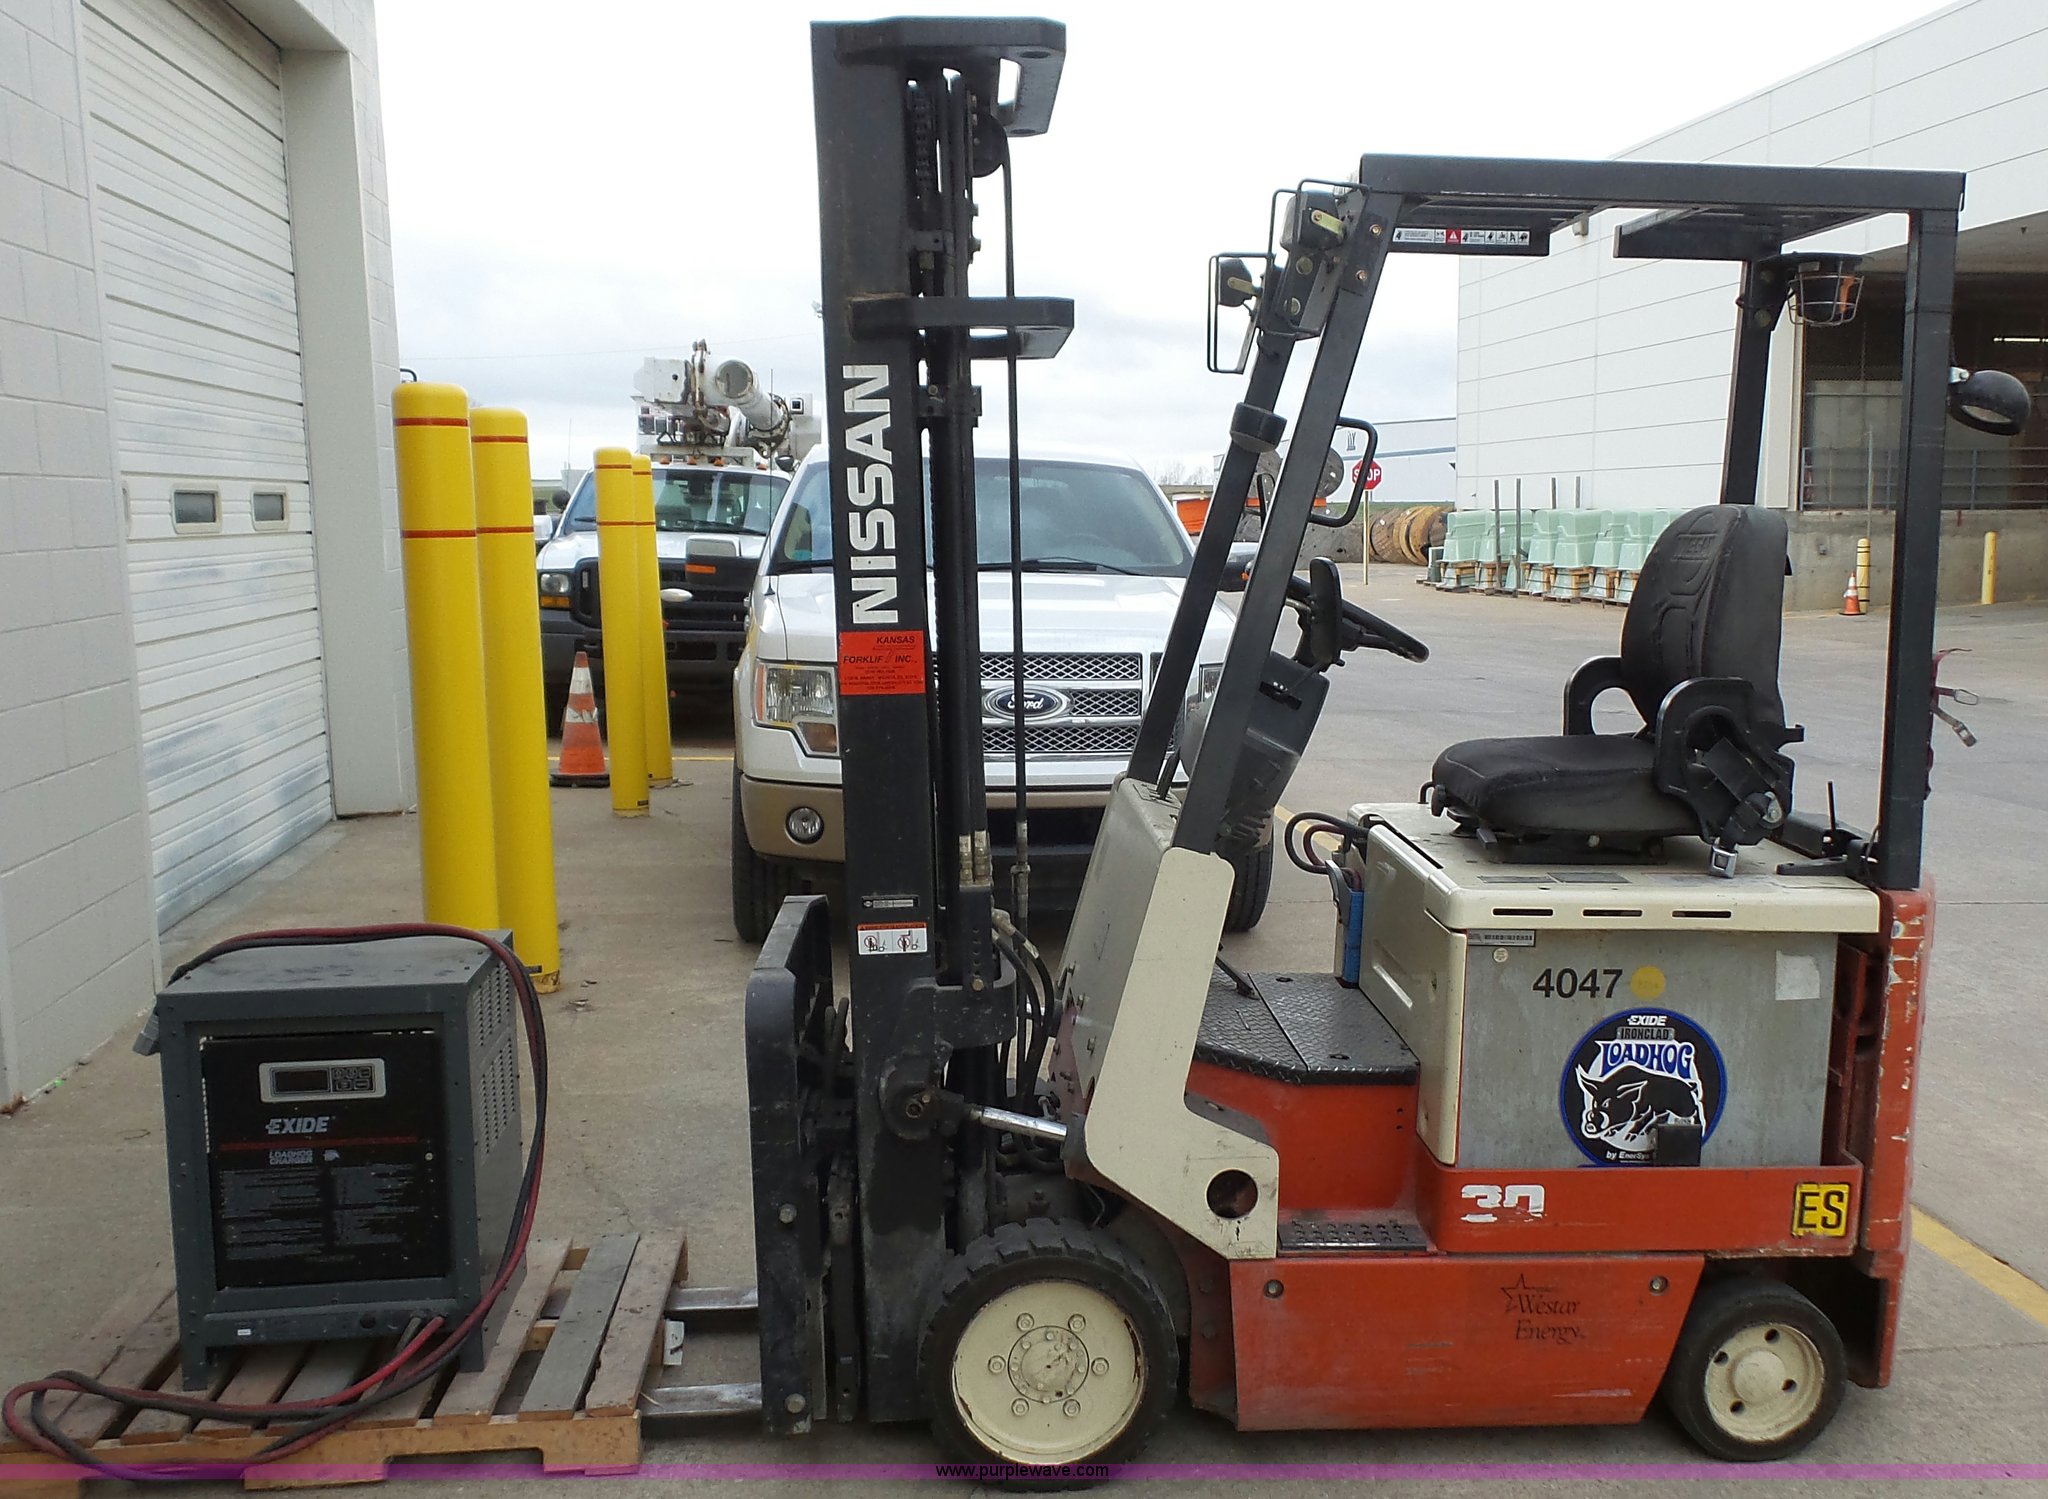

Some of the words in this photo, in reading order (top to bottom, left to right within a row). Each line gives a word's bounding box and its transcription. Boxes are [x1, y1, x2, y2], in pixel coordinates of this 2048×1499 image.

[842, 364, 898, 624] NISSAN
[876, 635, 915, 644] KANSAS
[1532, 967, 1623, 998] 4047
[1627, 1015, 1667, 1026] EXIDE
[1620, 1028, 1670, 1040] IRONCLAD
[1600, 1043, 1694, 1079] LOADHOG
[265, 1116, 330, 1134] EXIDE
[1606, 1151, 1618, 1161] by
[1798, 1190, 1844, 1229] ES
[1518, 1294, 1580, 1314] Westar
